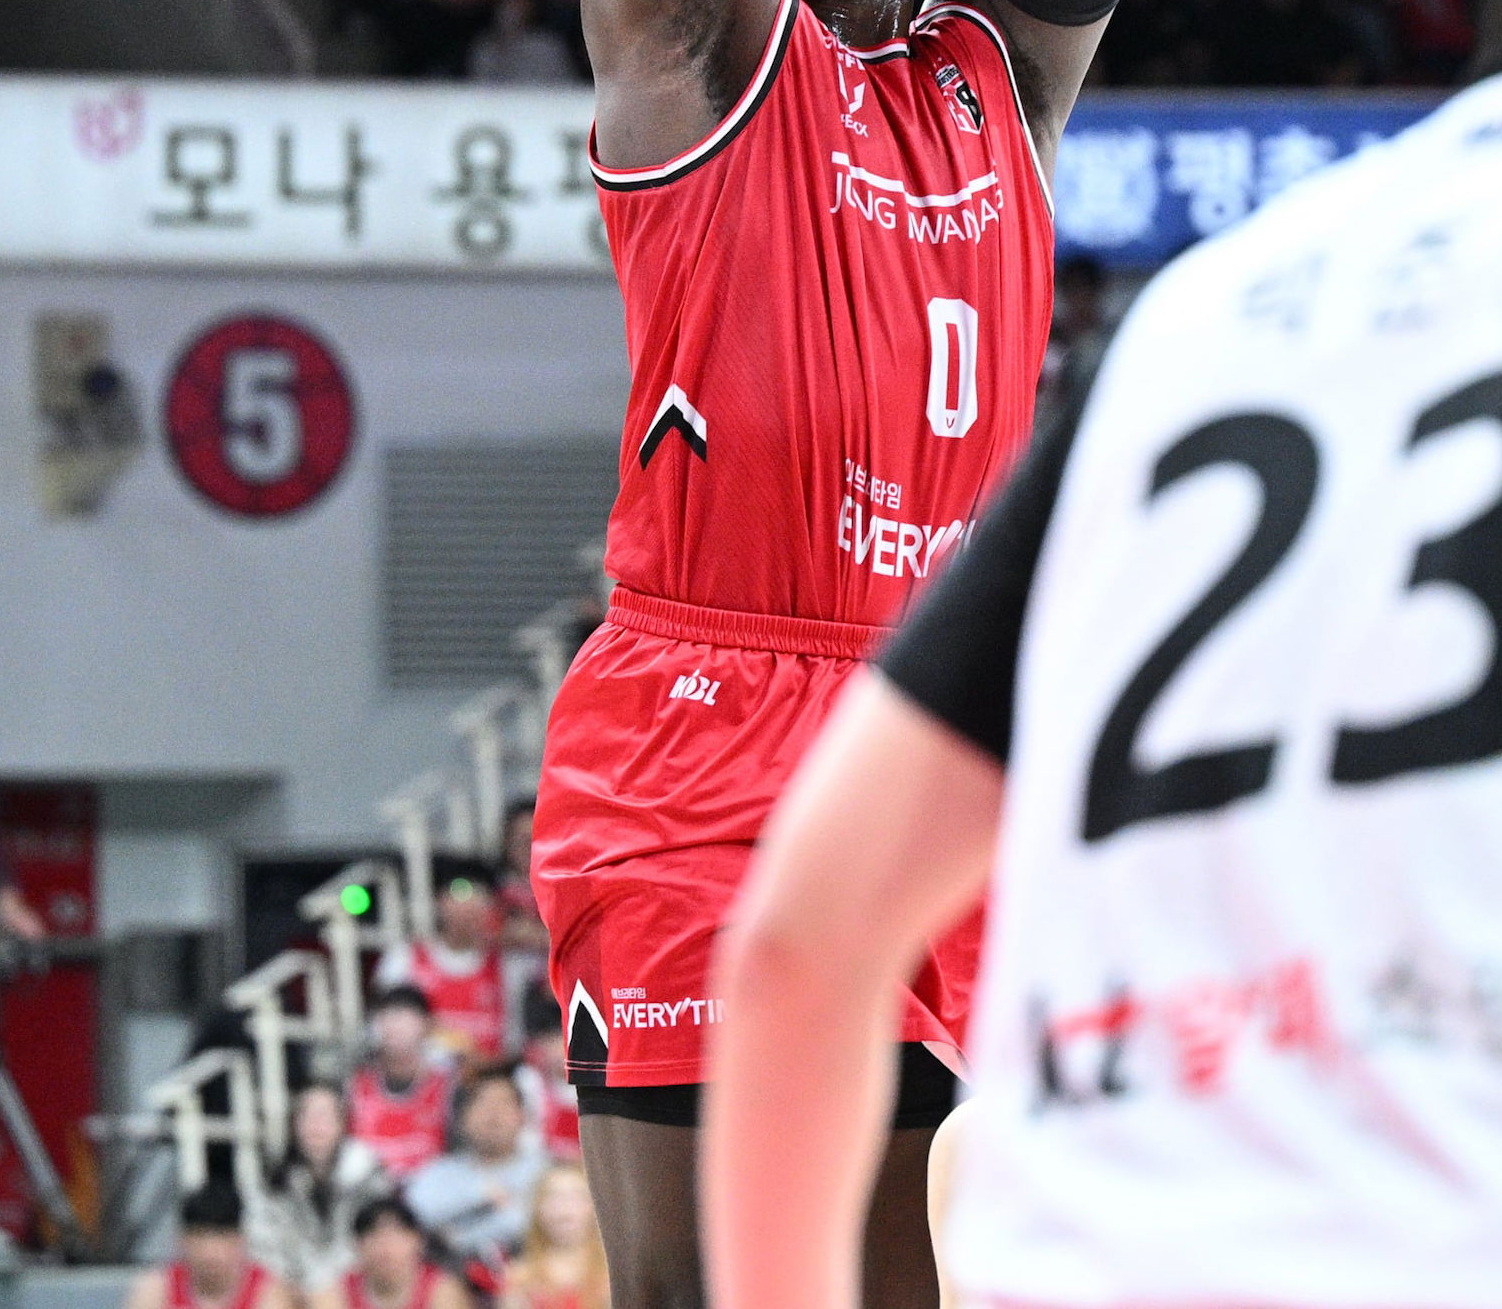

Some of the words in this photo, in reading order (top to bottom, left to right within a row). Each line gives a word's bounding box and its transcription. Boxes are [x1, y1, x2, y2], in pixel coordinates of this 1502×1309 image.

[829, 171, 896, 230] JUNG
[218, 347, 304, 483] 5
[926, 296, 979, 439] 0
[668, 668, 722, 707] KBL
